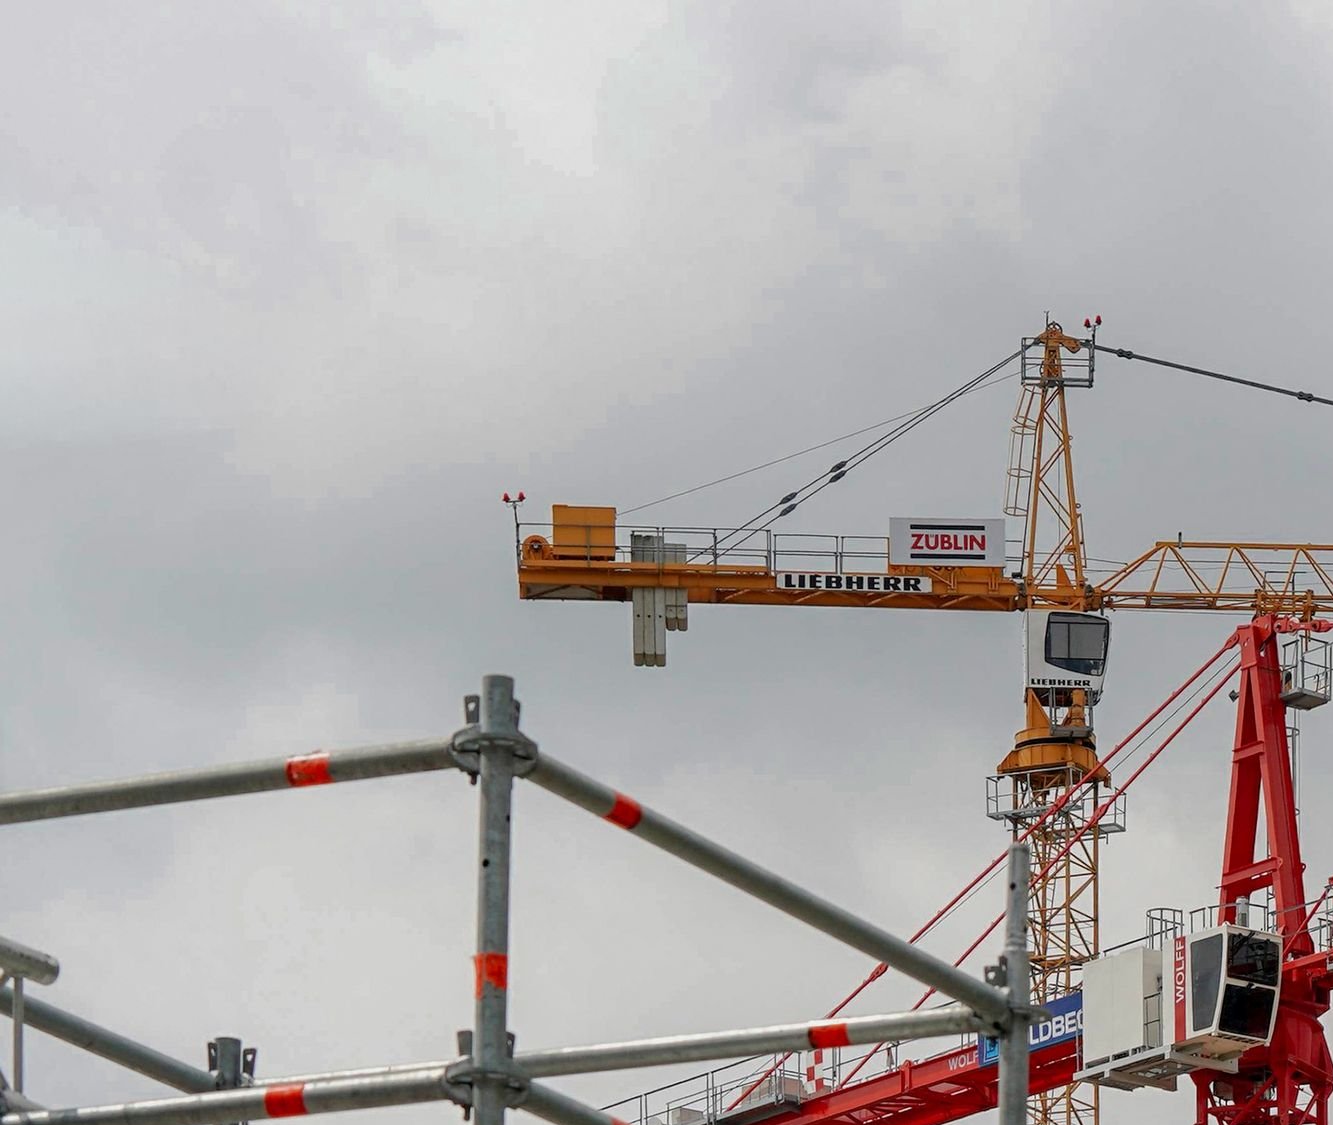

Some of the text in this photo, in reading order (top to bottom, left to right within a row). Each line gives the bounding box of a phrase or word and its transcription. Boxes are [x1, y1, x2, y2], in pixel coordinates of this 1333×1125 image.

[784, 574, 922, 592] LIEBHERR
[1030, 678, 1091, 687] LIEBHERR
[1175, 941, 1185, 1004] WOLFF
